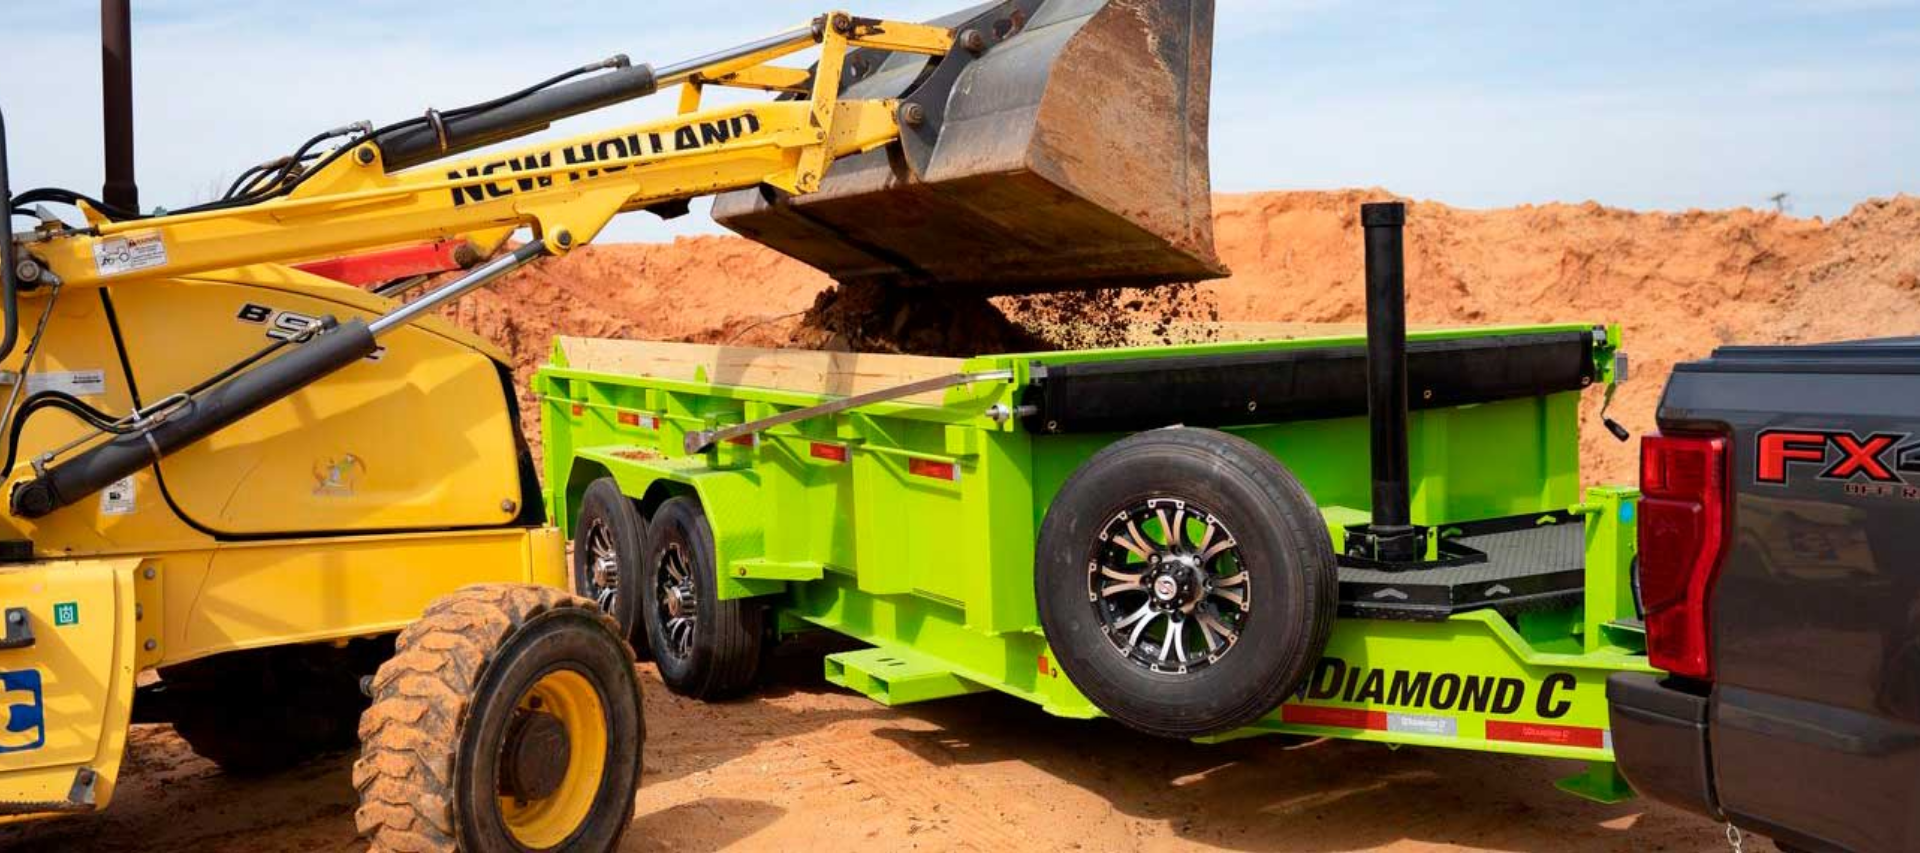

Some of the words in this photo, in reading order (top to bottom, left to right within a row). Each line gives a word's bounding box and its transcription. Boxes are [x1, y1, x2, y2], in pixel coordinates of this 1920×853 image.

[447, 150, 552, 206] NEW
[562, 113, 760, 181] HOLLAND
[1307, 656, 1526, 714] DIAMOND
[1535, 672, 1577, 719] C
